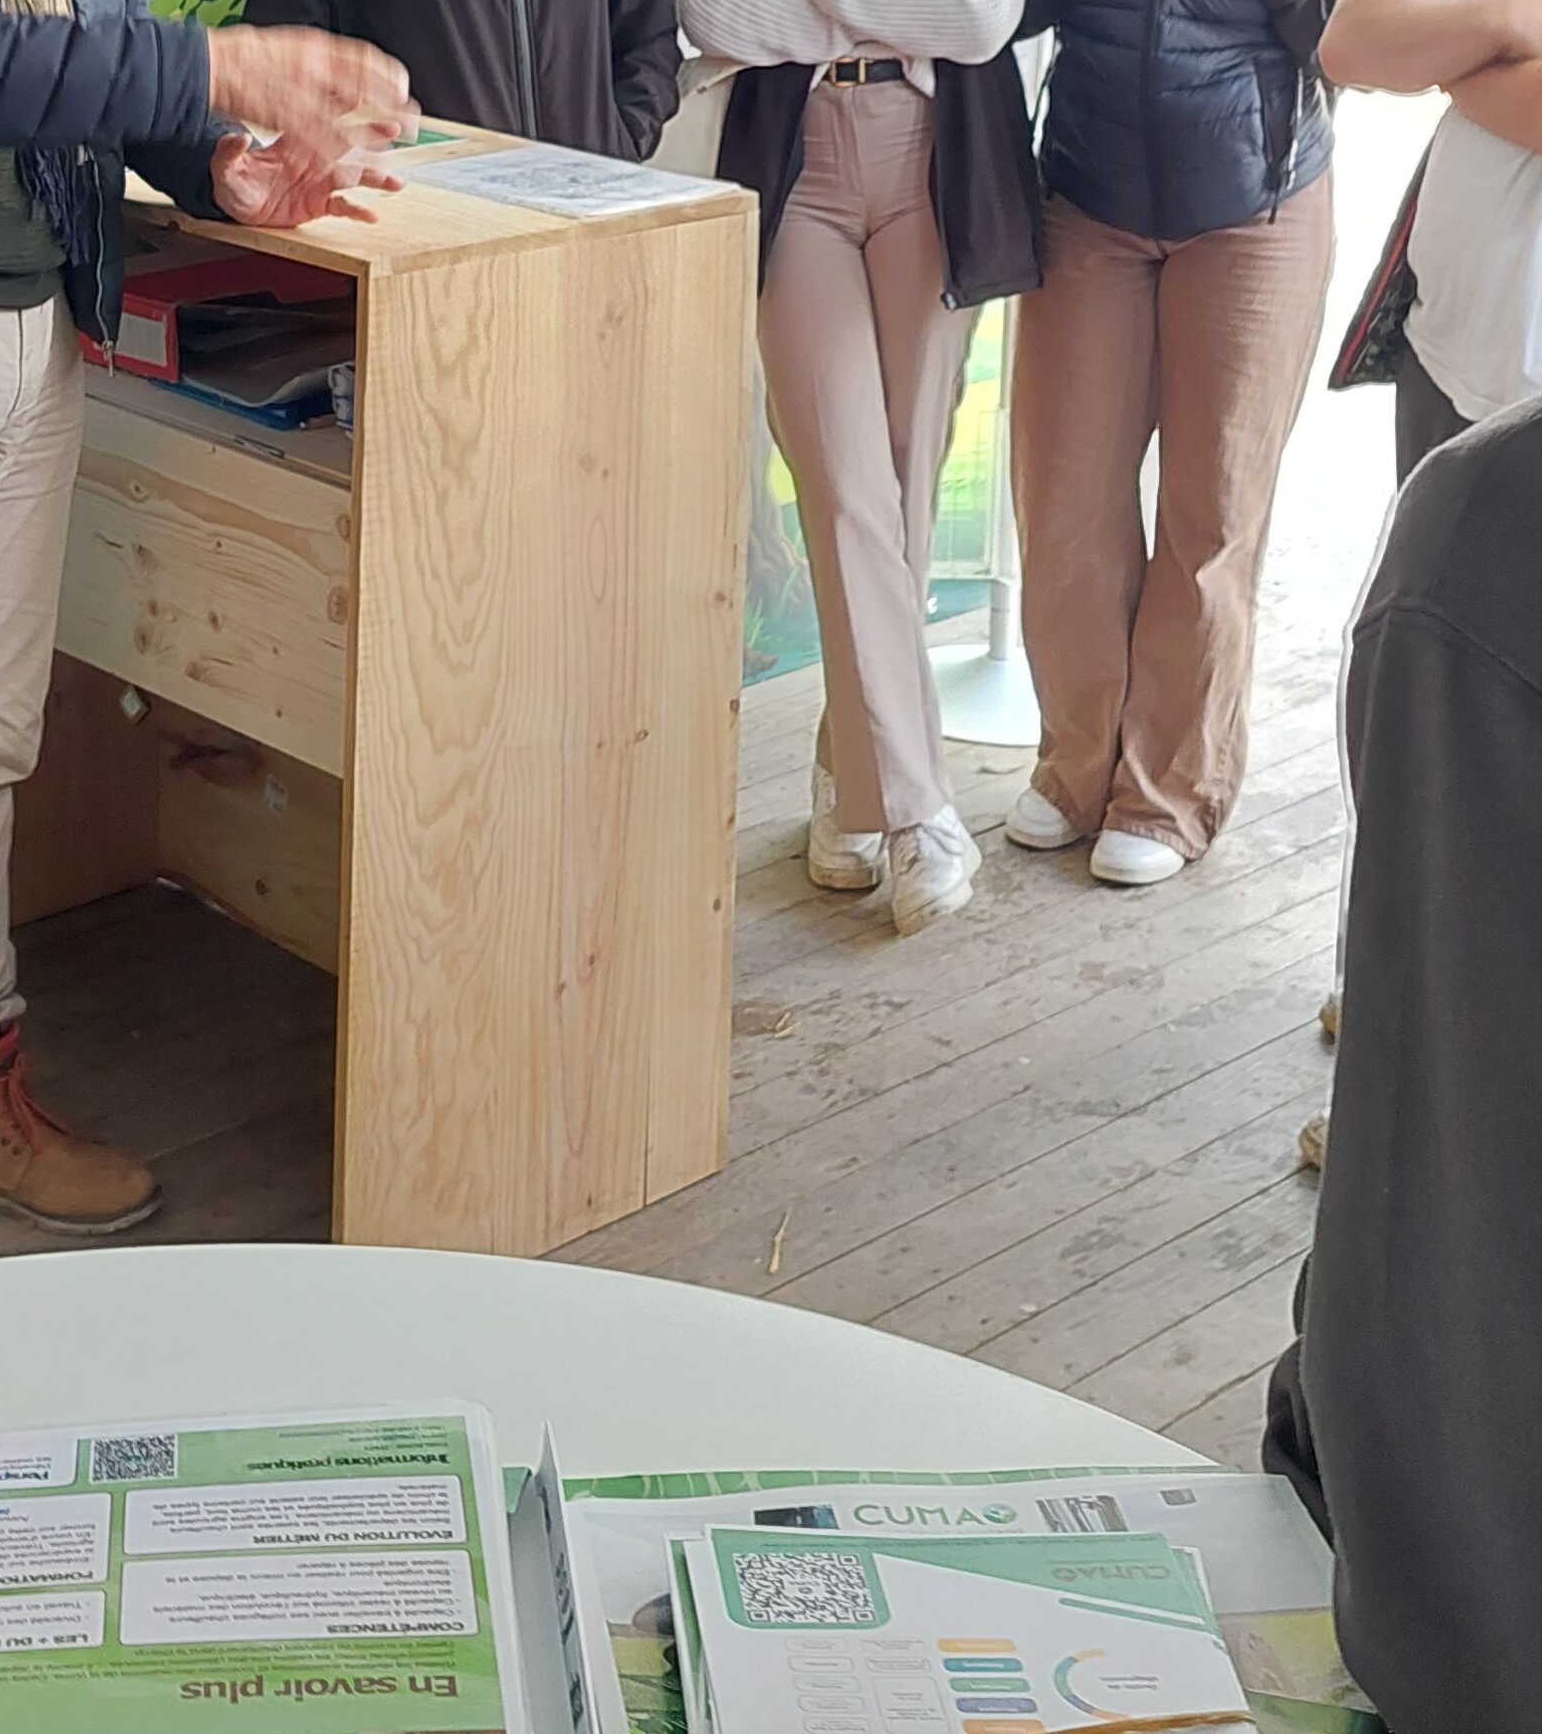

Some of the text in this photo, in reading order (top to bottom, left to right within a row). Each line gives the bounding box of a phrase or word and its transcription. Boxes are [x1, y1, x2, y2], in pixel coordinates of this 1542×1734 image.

[335, 1454, 451, 1467] Informations
[852, 1503, 986, 1527] CUMA
[252, 1530, 453, 1544] ÉVOLUTION DU MÉTIER
[326, 1622, 464, 1633] COMPÉTENCES
[6, 1637, 32, 1647] DU
[53, 1634, 89, 1644] LES
[180, 1674, 264, 1705] plus
[275, 1674, 397, 1702] savoir
[409, 1675, 459, 1698] En
